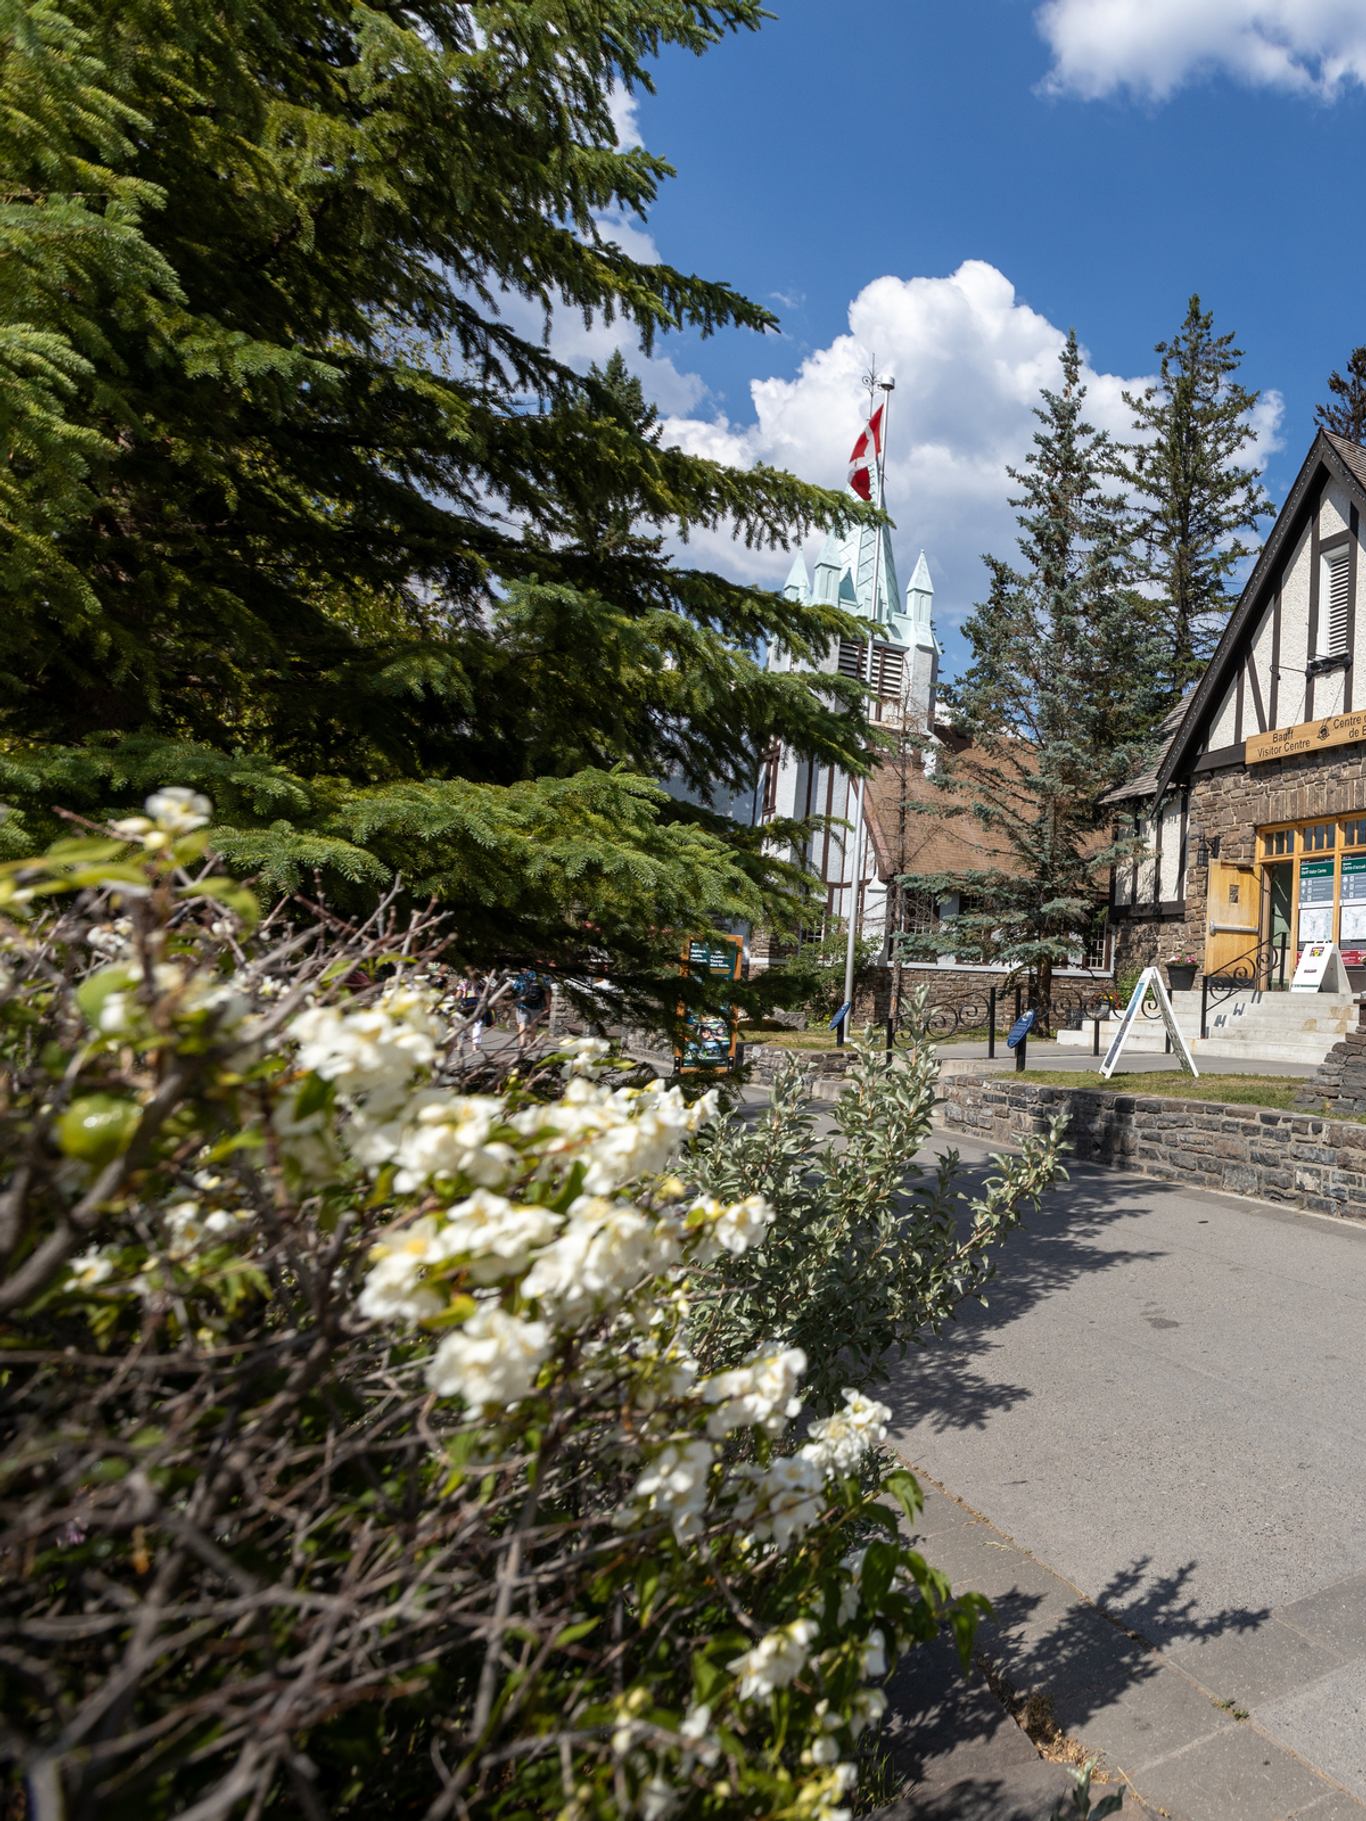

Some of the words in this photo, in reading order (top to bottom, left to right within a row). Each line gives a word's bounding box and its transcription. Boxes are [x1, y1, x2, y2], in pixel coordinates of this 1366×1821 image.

[1333, 716, 1361, 729] Centre
[1272, 728, 1294, 743] Banff
[1349, 728, 1359, 738] de
[1257, 745, 1281, 758] Visitor
[1284, 739, 1310, 752] Centre
